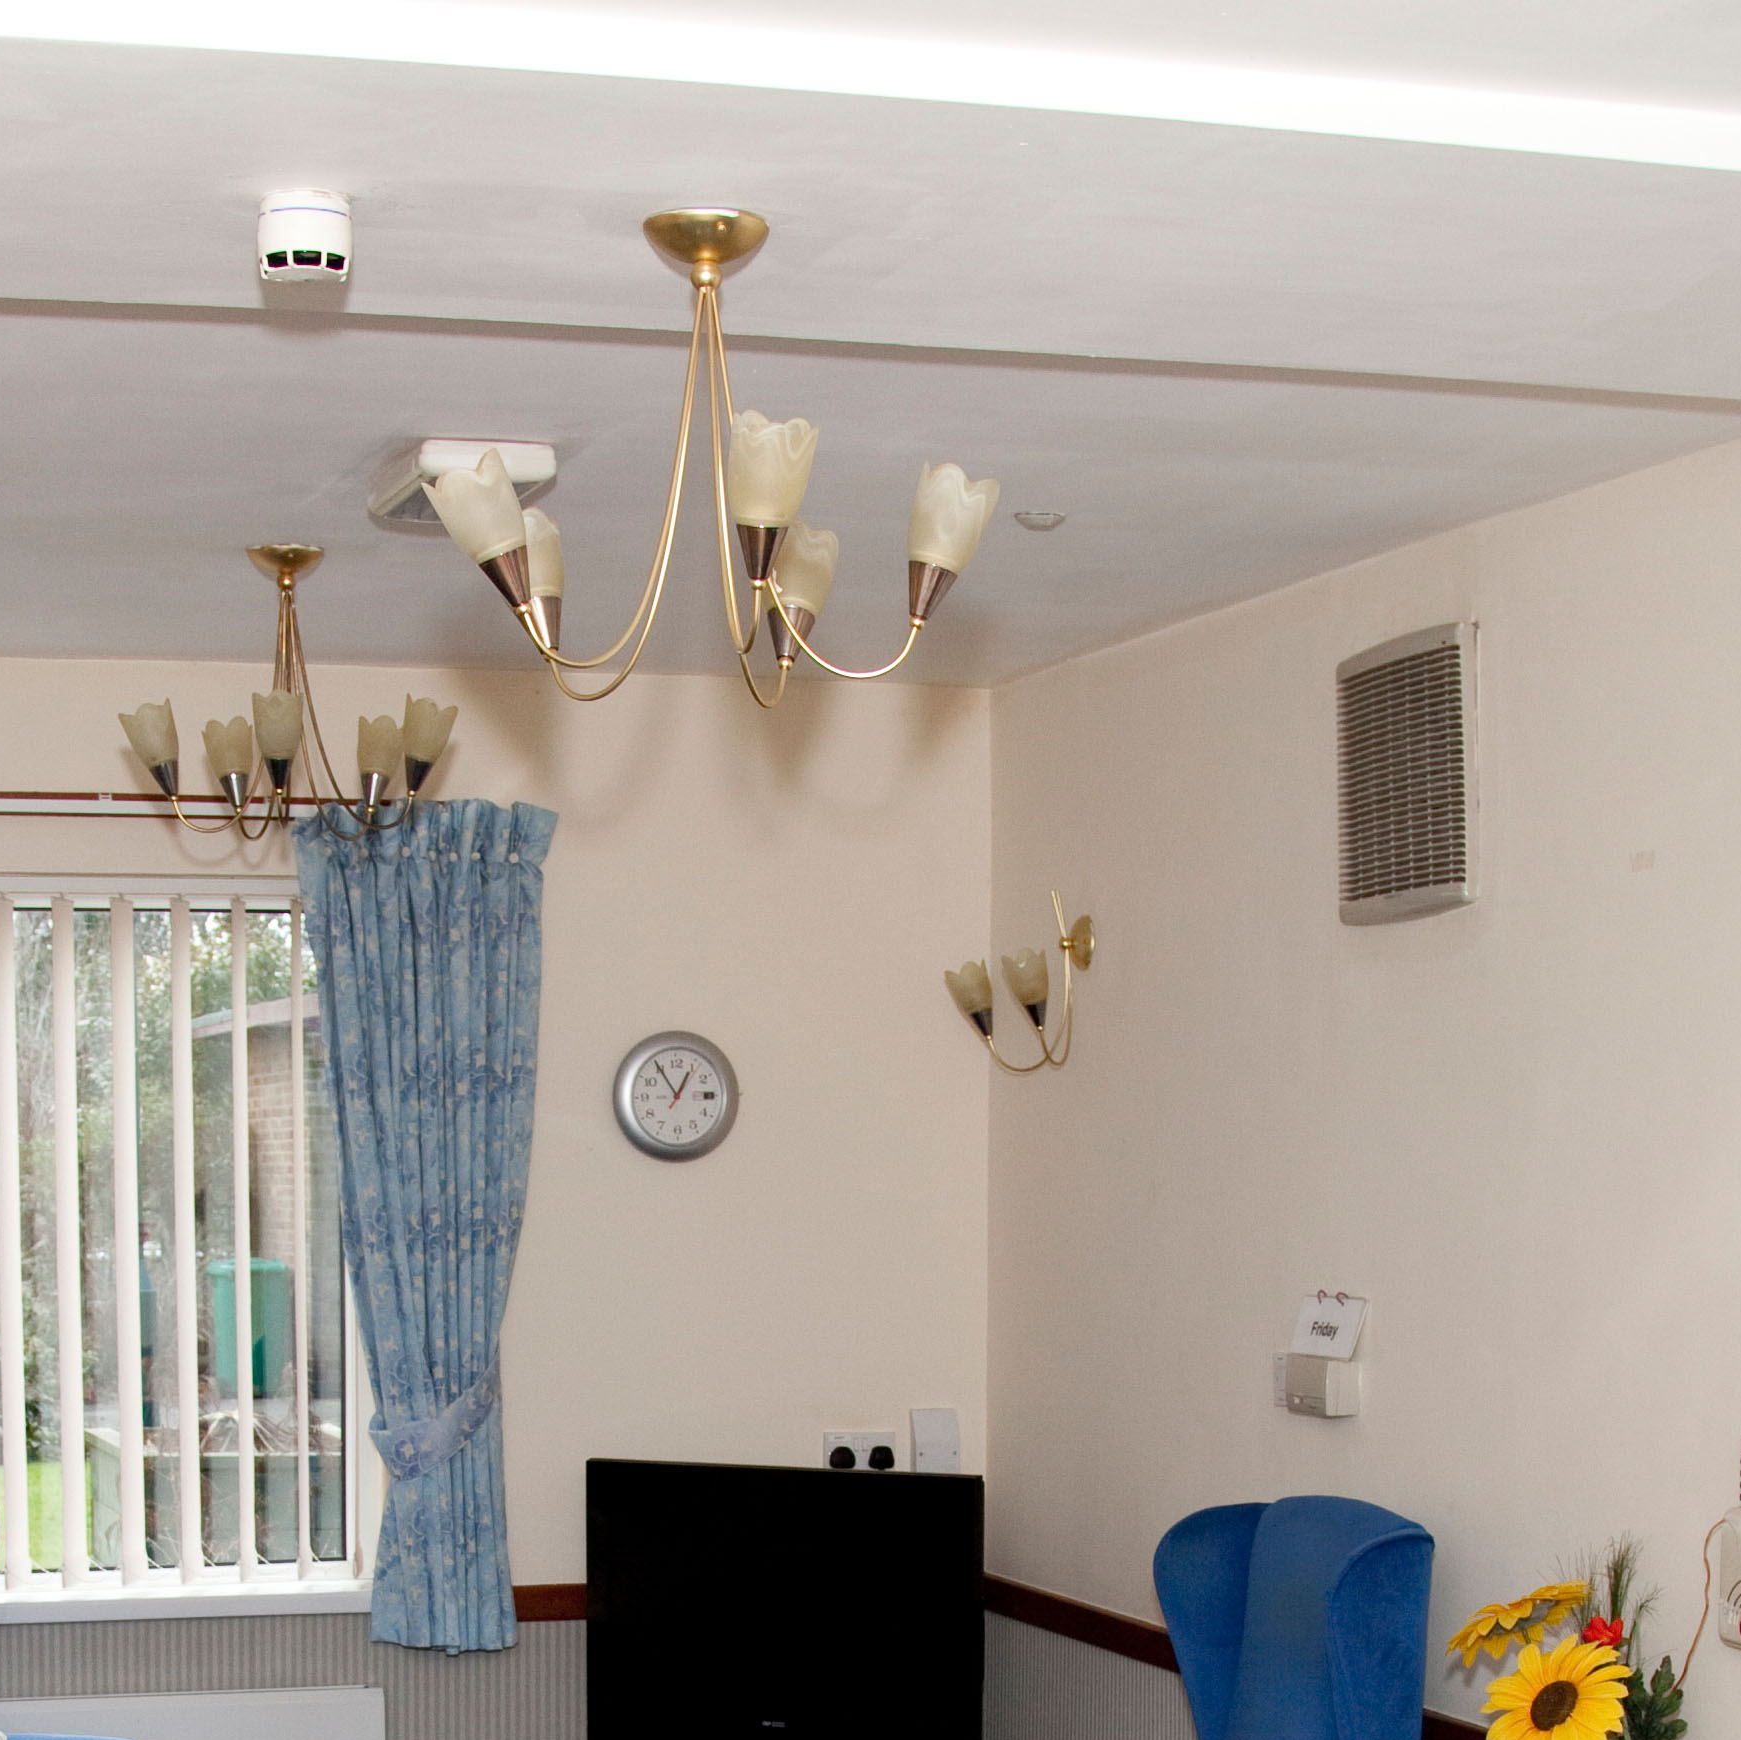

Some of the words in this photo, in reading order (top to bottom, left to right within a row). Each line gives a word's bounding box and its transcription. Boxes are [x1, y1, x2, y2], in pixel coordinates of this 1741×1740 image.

[670, 1058, 684, 1069] 12
[644, 1077, 657, 1087] 10
[699, 1073, 708, 1085] 2
[640, 1092, 649, 1102] 9
[645, 1108, 654, 1119] 8
[699, 1107, 707, 1117] 4
[657, 1120, 666, 1130] 7
[688, 1119, 698, 1130] 5
[674, 1125, 682, 1135] 6
[1310, 1321, 1340, 1341] Friday
